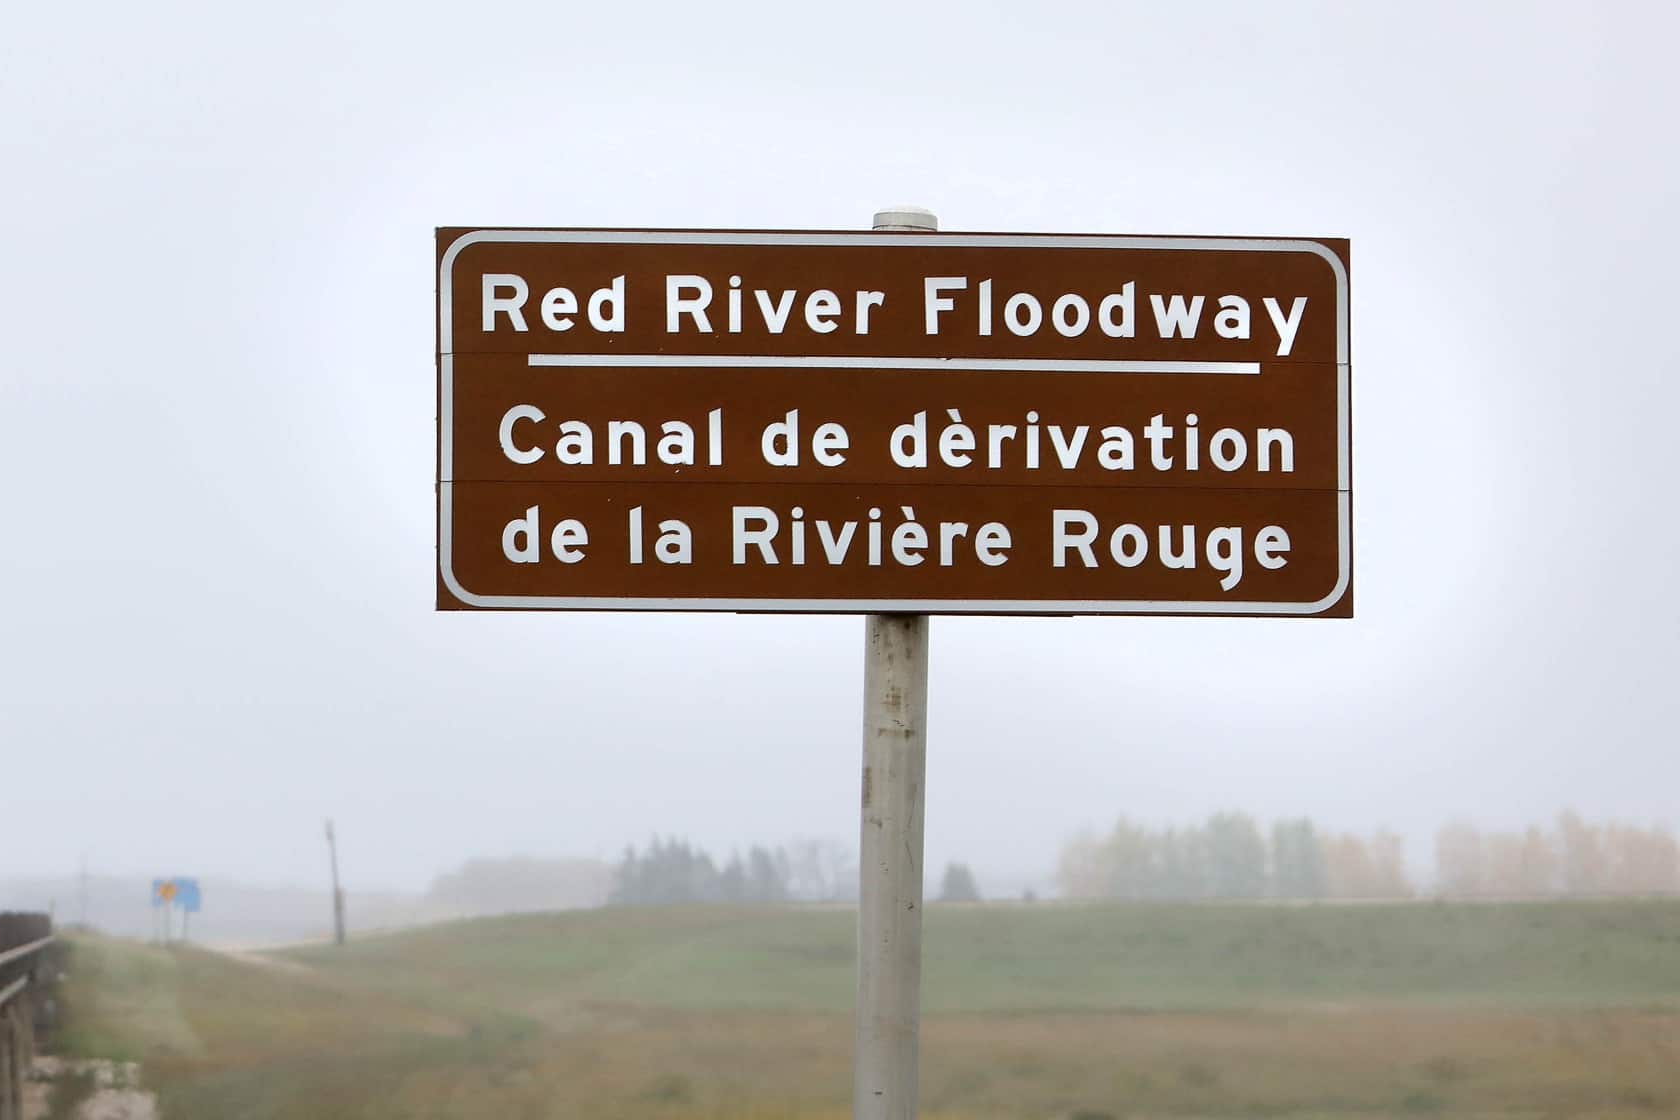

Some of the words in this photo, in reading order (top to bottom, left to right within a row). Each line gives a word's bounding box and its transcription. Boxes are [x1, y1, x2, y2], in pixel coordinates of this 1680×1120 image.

[482, 273, 625, 333] Red
[666, 274, 885, 335] River
[924, 276, 1308, 357] Floodway
[498, 404, 722, 466] Canal
[761, 408, 850, 467] de
[889, 408, 1294, 473] dèrivation
[502, 504, 589, 564] de
[629, 505, 692, 564] la
[732, 505, 1012, 567] Rivière
[1052, 509, 1291, 592] Rouge
